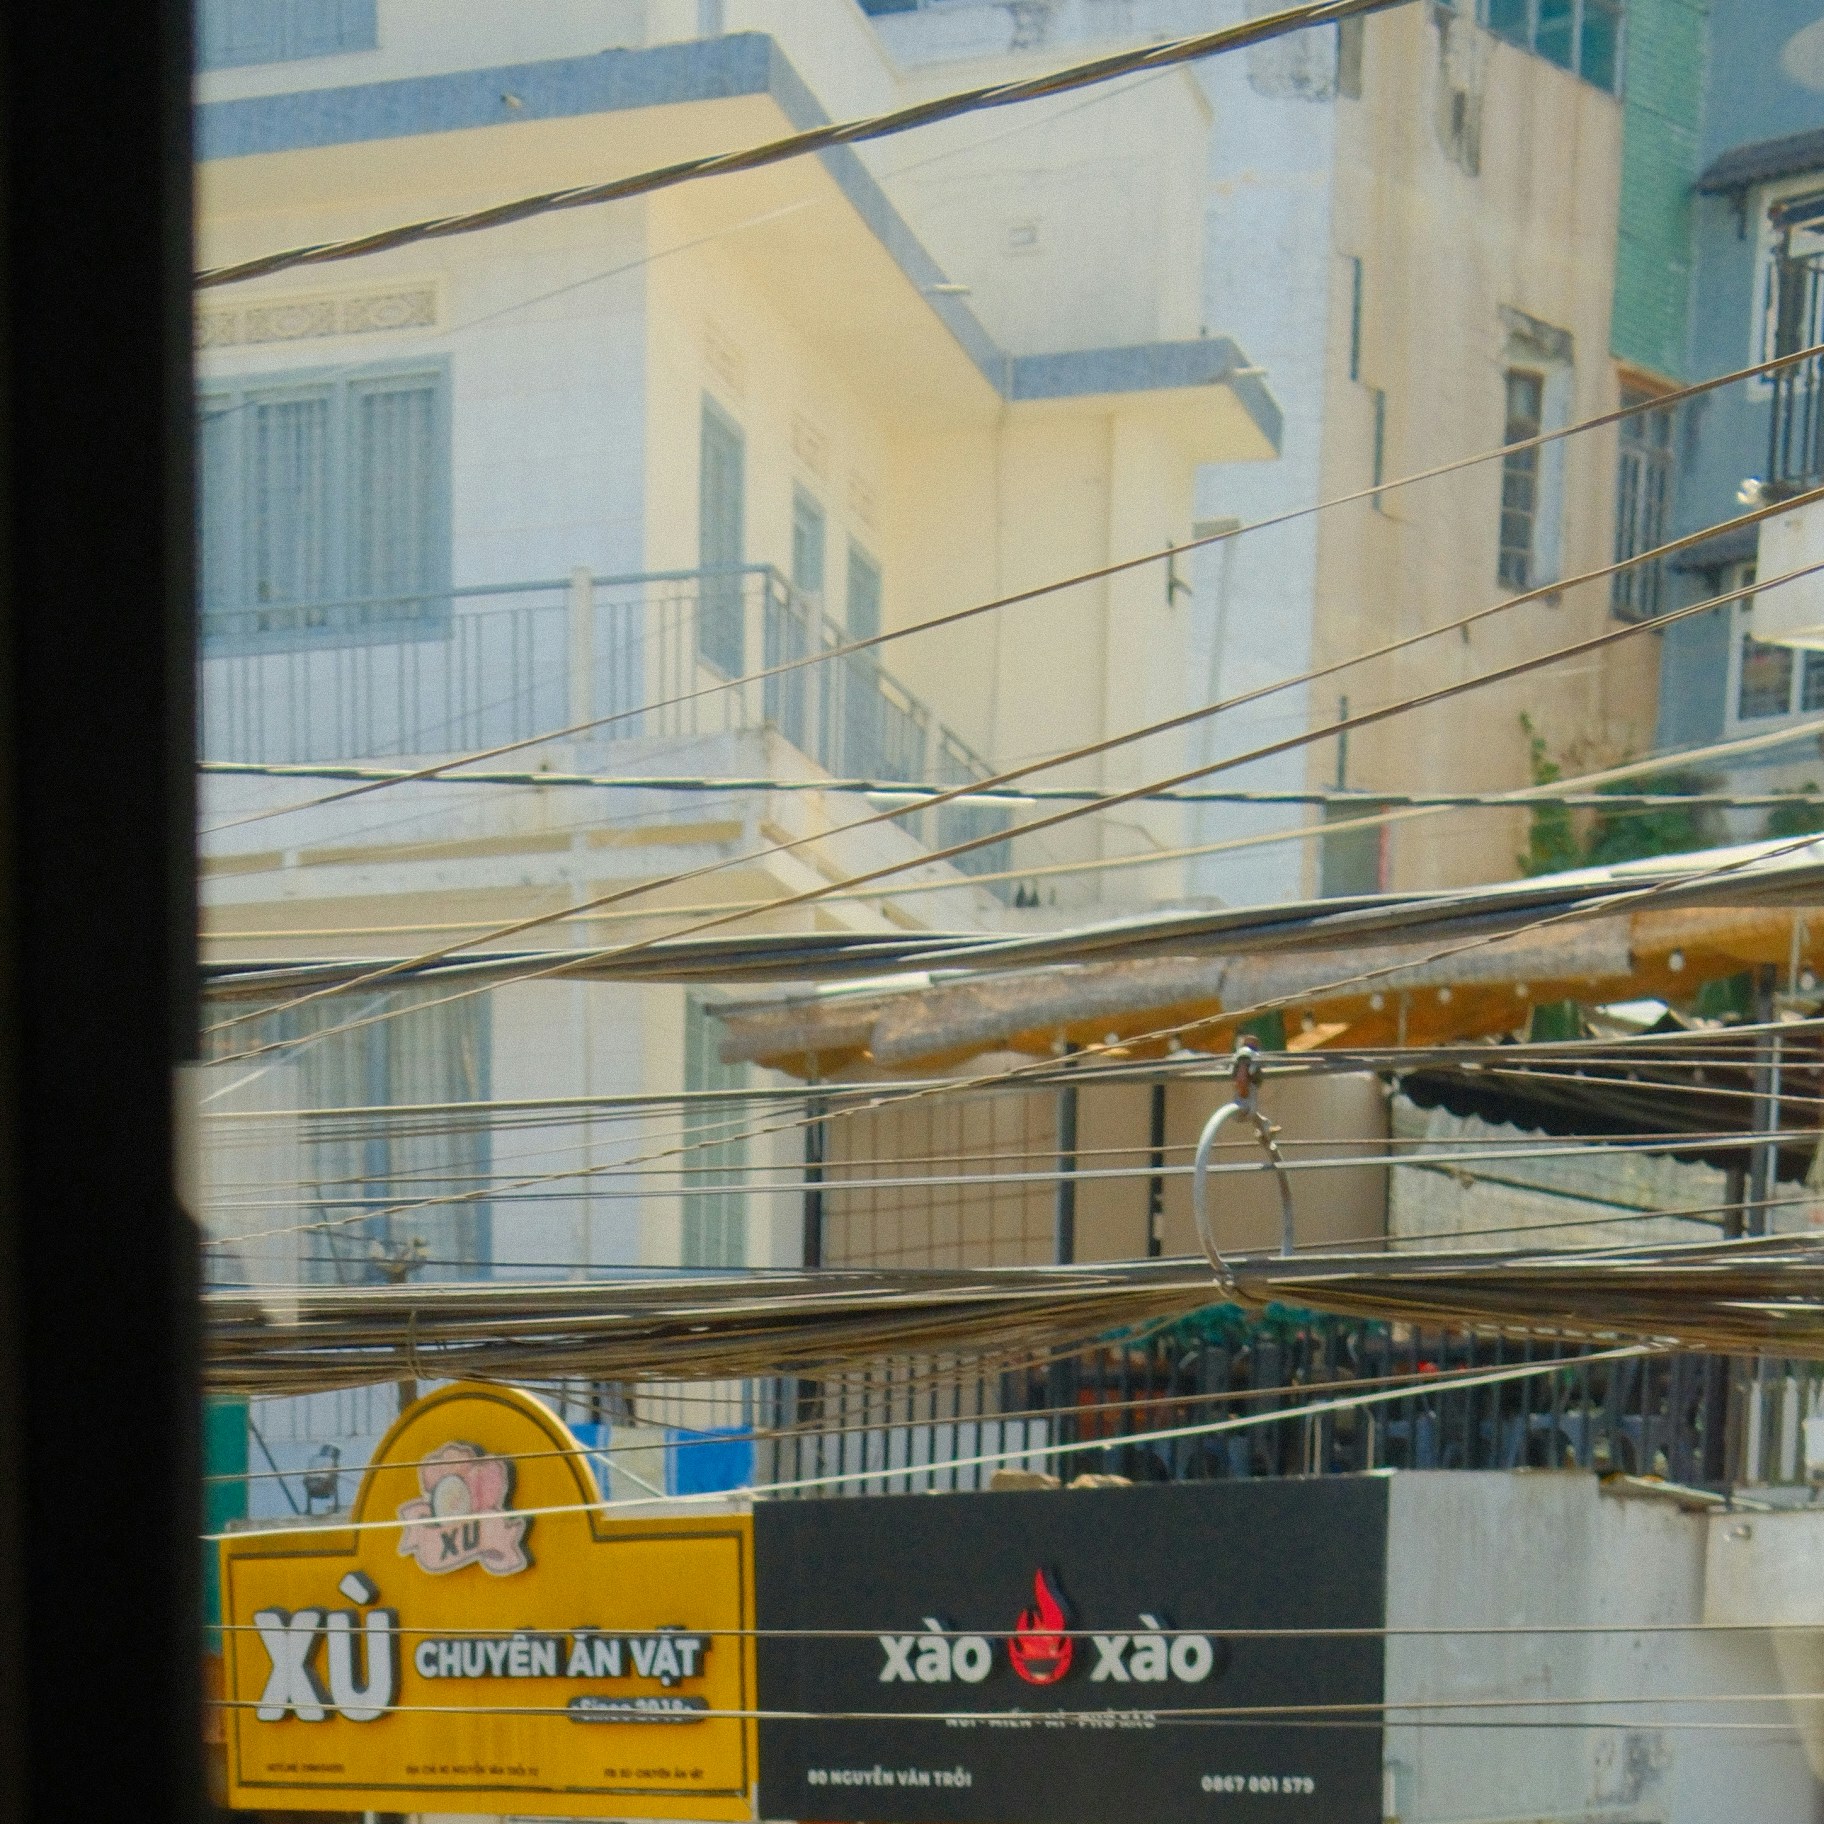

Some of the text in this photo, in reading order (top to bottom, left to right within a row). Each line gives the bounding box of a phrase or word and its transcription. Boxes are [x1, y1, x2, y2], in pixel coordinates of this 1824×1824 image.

[254, 1571, 396, 1722] XÙ
[415, 1629, 559, 1678] CHUYÊN
[878, 1617, 993, 1683] xào
[1090, 1613, 1214, 1683] xào
